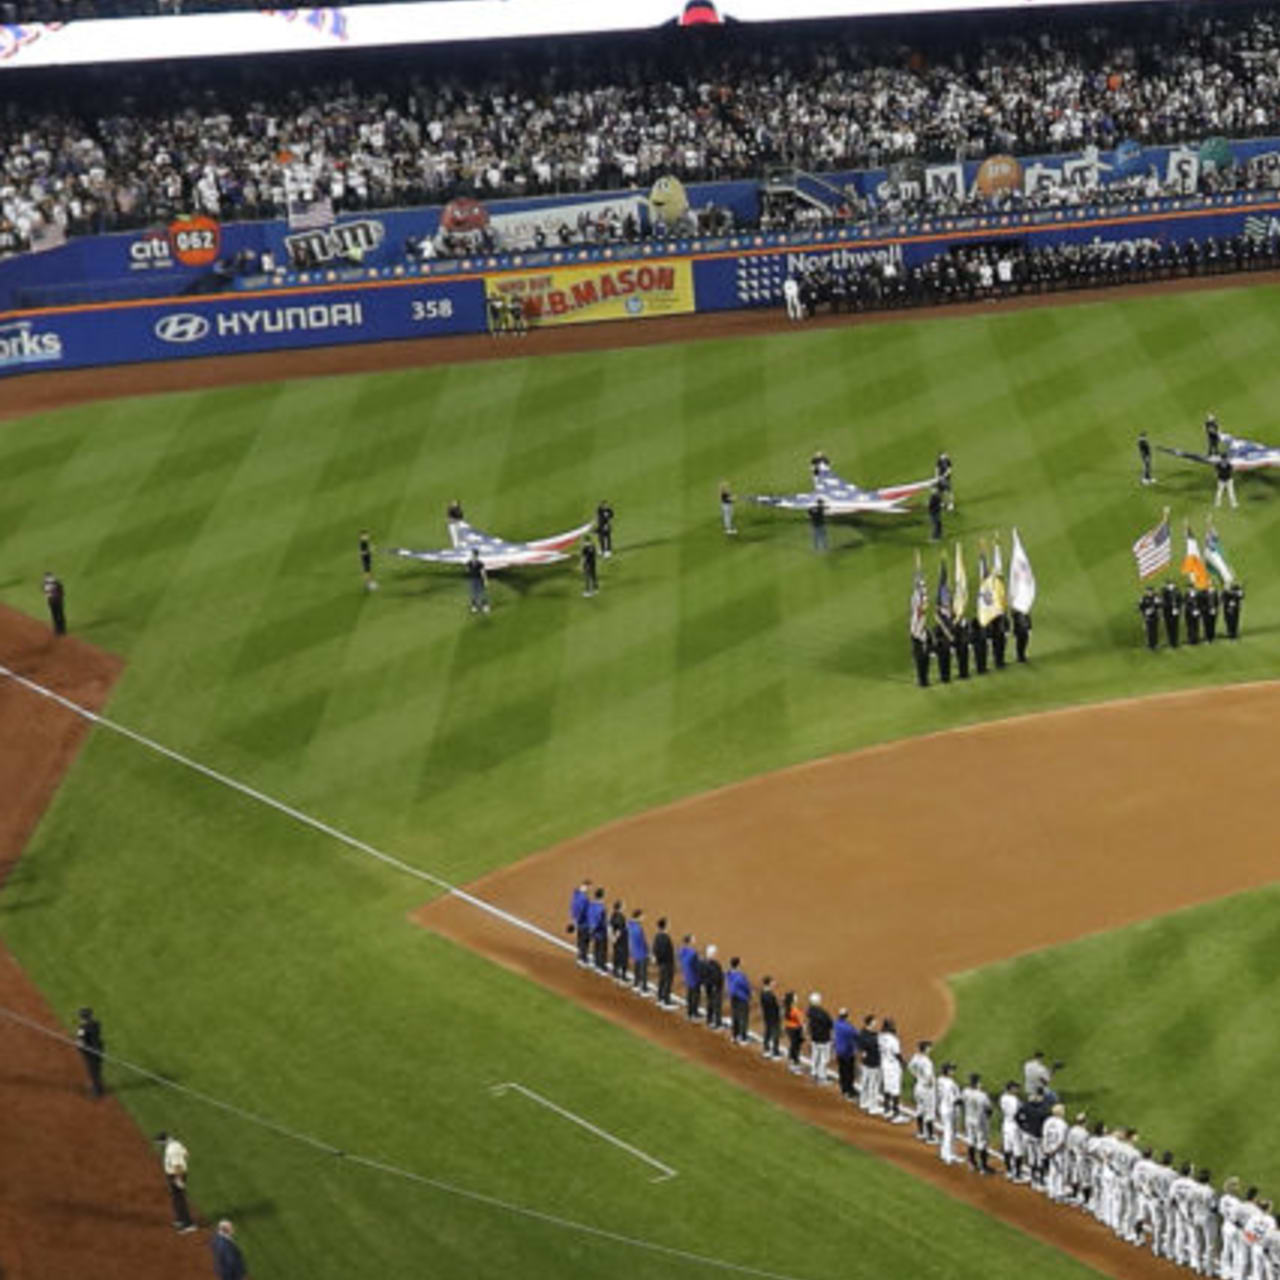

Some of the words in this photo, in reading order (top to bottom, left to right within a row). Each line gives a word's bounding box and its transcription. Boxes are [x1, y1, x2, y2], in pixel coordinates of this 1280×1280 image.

[786, 242, 901, 276] Northwell
[216, 303, 363, 337] HYUNDAI
[411, 298, 453, 320] 358
